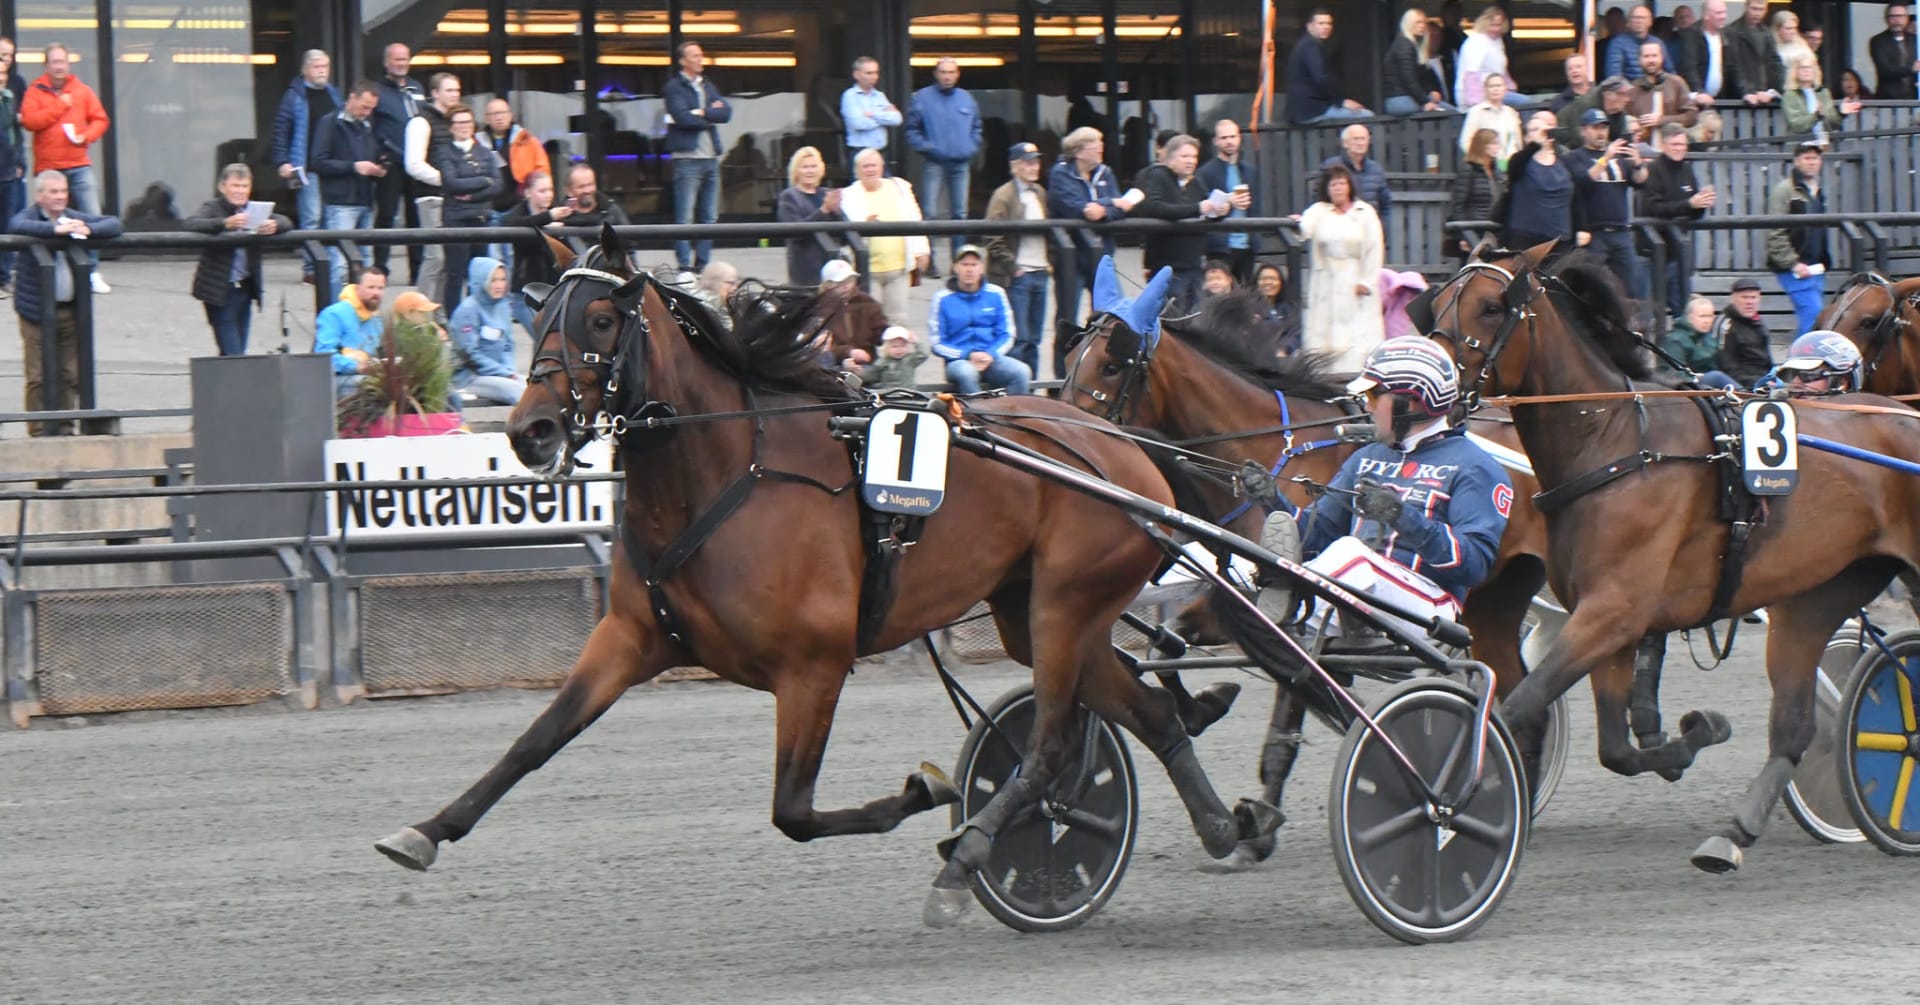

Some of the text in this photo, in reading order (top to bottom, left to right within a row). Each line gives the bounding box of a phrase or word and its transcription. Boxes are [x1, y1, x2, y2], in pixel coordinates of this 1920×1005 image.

[893, 412, 919, 482] 1
[1756, 403, 1787, 468] 3
[889, 493, 931, 508] Megaflis
[1492, 483, 1514, 519] G
